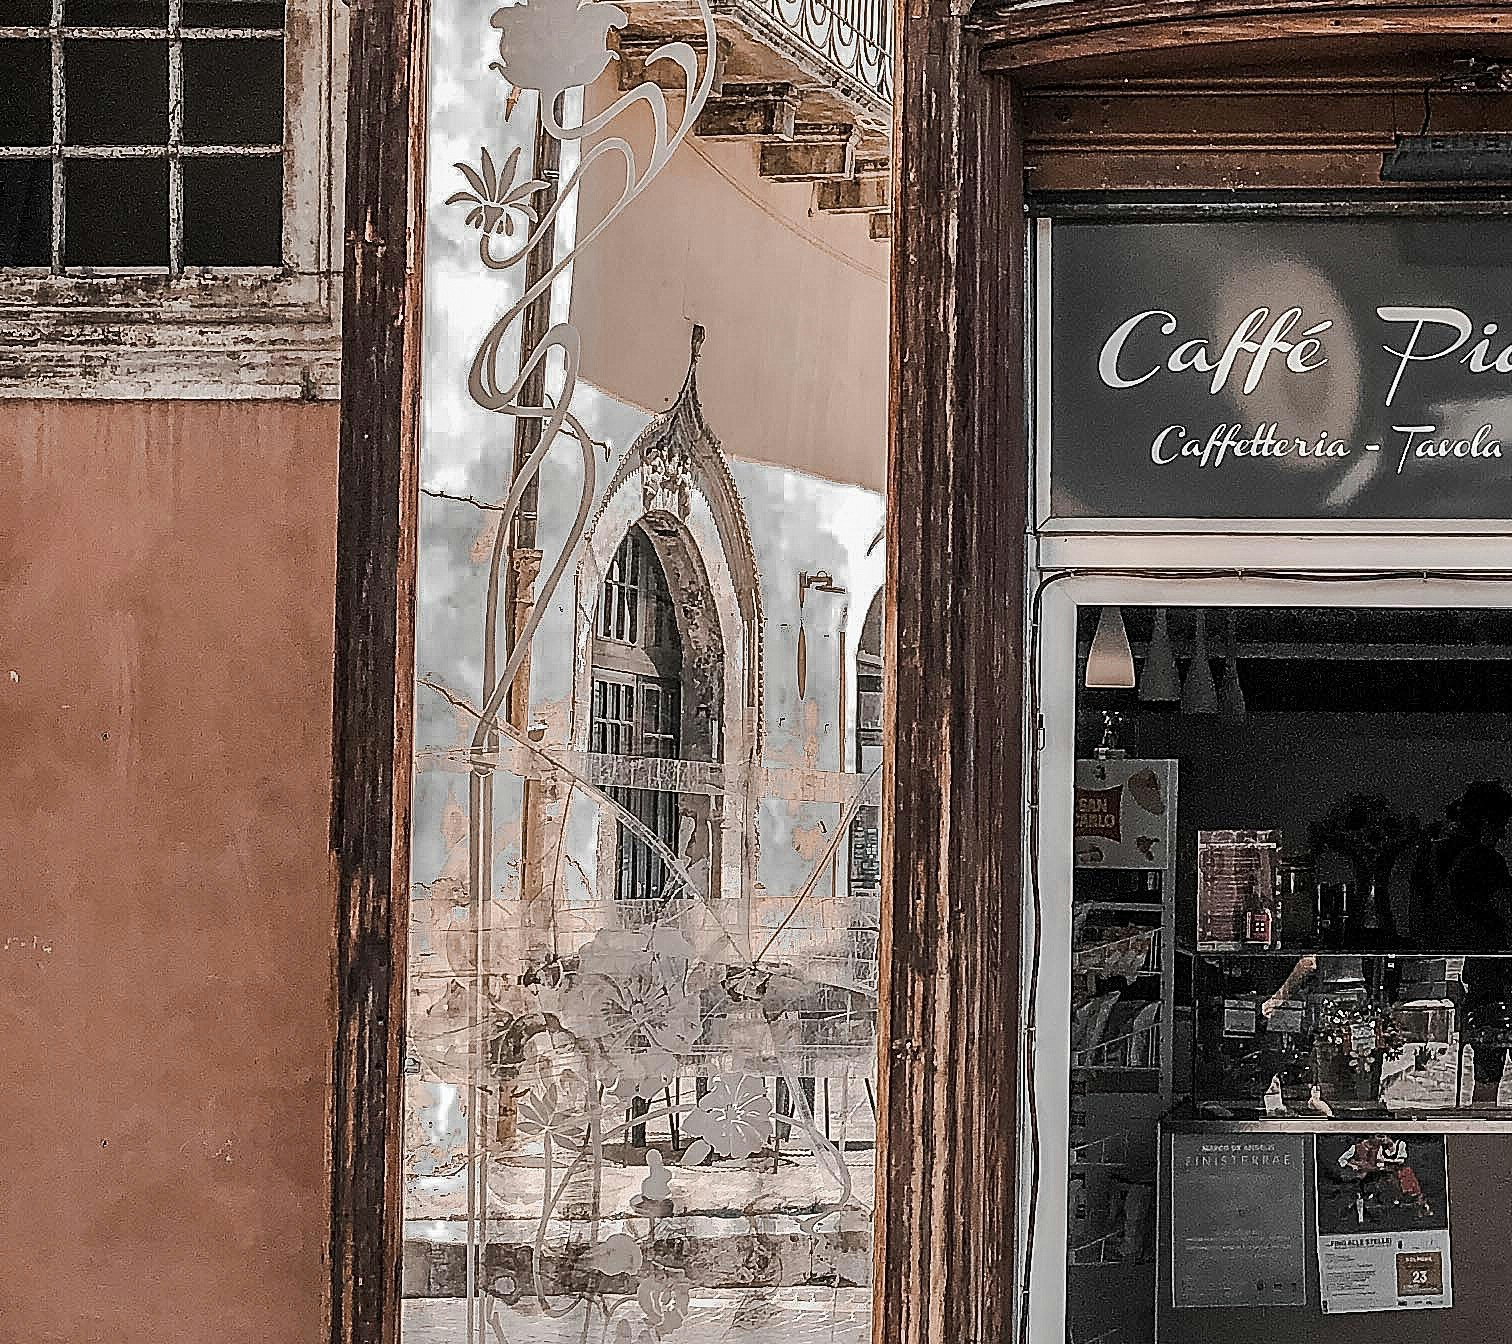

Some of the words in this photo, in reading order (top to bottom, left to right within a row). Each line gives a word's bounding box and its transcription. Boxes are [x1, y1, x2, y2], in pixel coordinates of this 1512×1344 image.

[1098, 307, 1333, 395] Caffé
[1151, 422, 1350, 467] Caffetteria
[1391, 424, 1503, 474] Tavola
[1412, 1270, 1428, 1284] 23
